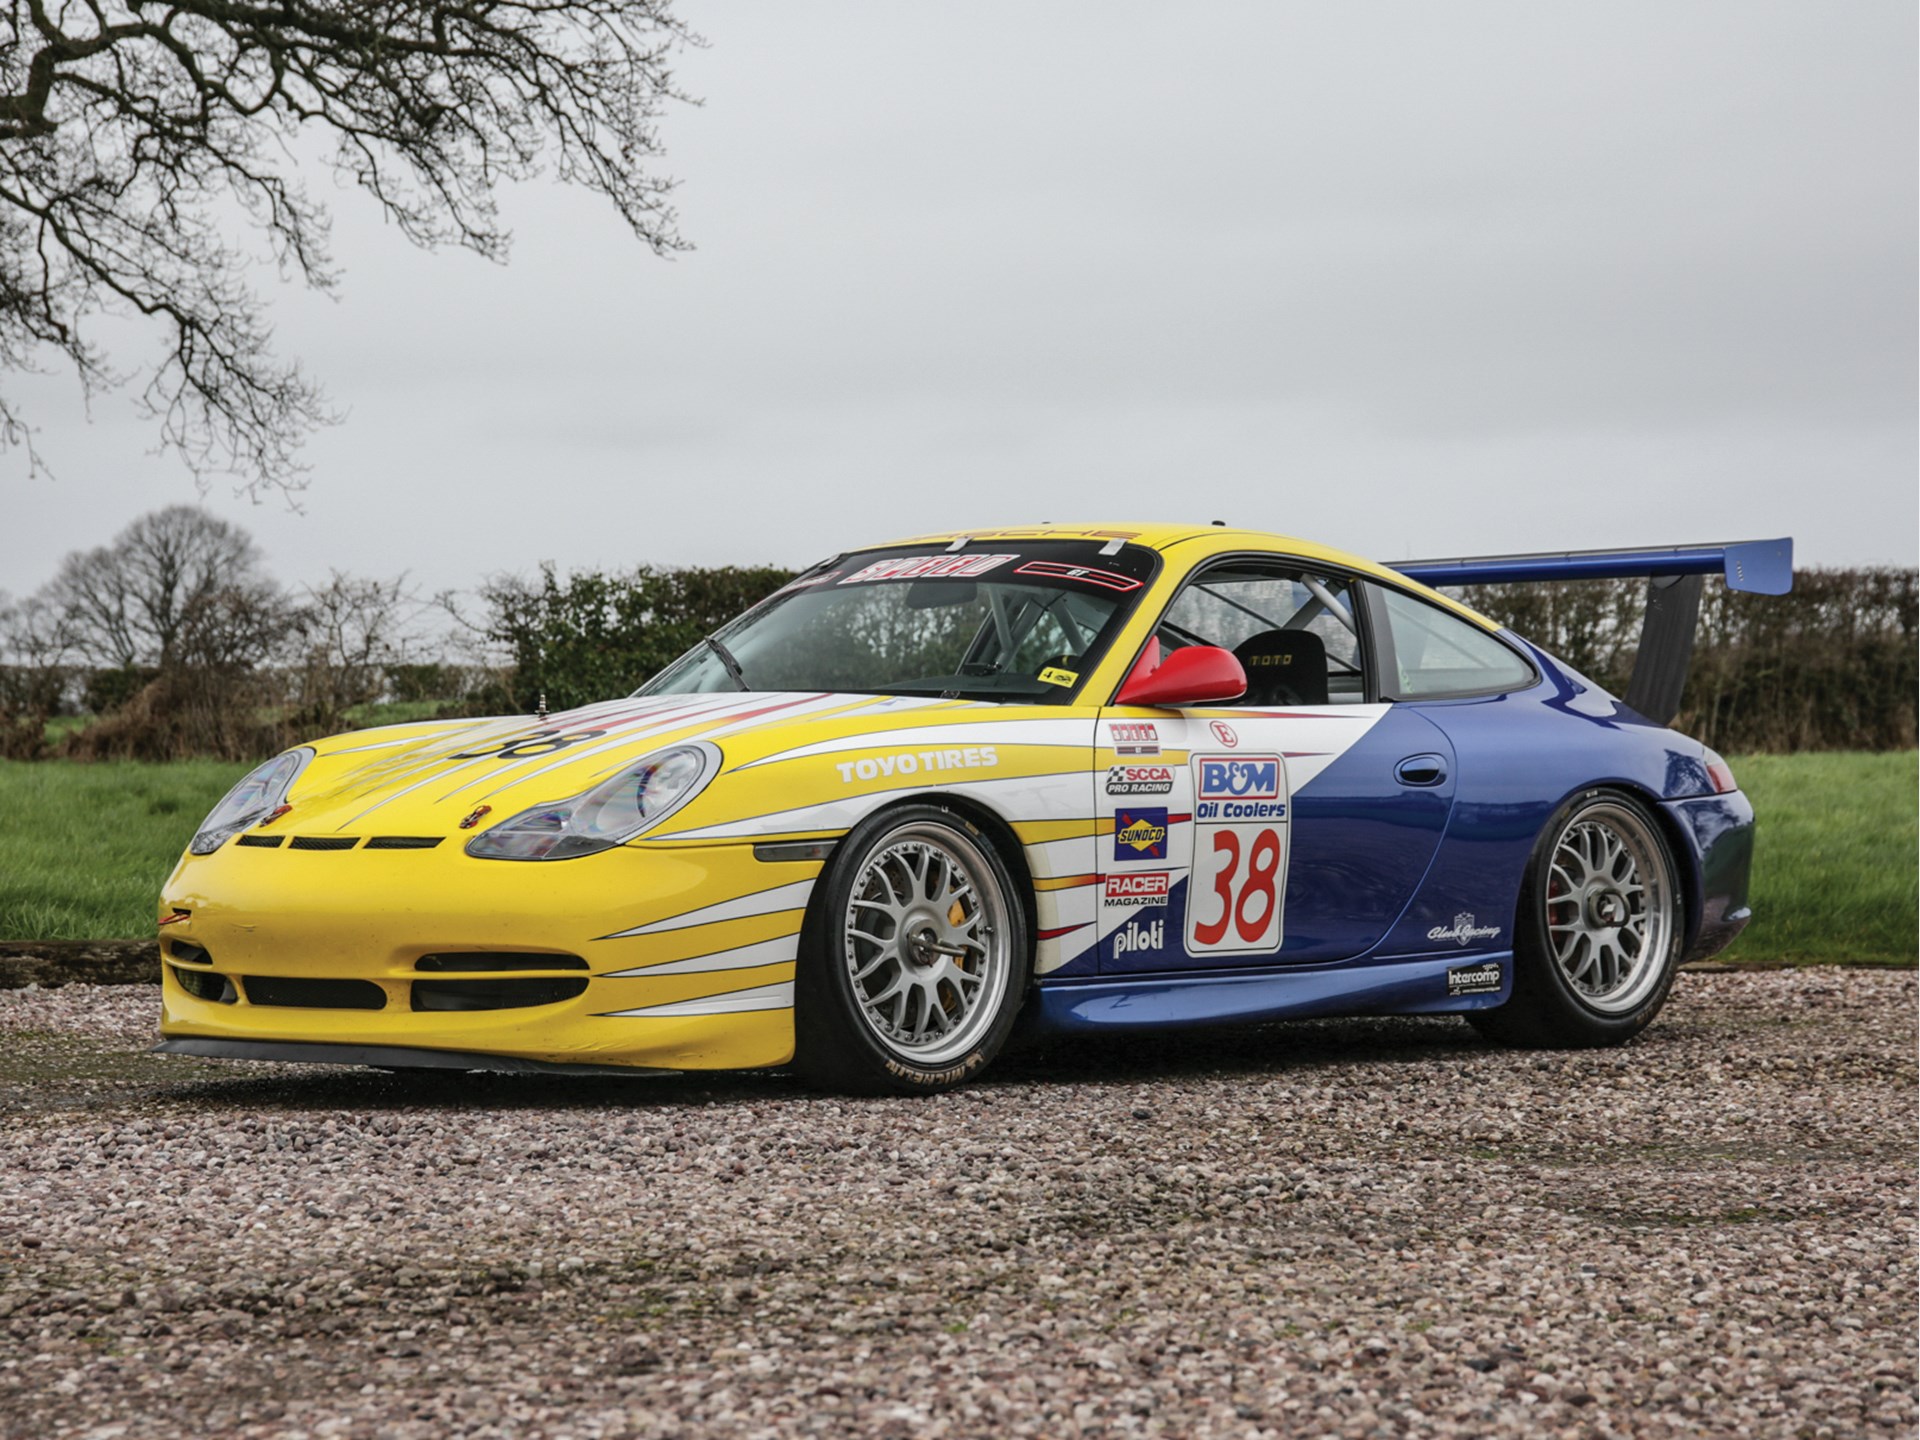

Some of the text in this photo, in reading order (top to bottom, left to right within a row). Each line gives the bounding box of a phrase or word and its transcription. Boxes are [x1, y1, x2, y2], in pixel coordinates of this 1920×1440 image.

[836, 553, 1021, 586] SPEED
[1250, 654, 1293, 666] TOTO
[1109, 724, 1158, 741] SPEED
[447, 730, 607, 760] 38
[836, 746, 998, 783] TOYO TIRES
[1126, 768, 1172, 781] SCCA
[1202, 762, 1276, 795] B&M
[1108, 783, 1171, 793] PRO RACING
[1197, 802, 1286, 818] Oil Coolers
[1119, 829, 1163, 843] SUNOCO
[1108, 876, 1167, 894] RACER
[1194, 828, 1280, 945] 38
[1104, 896, 1167, 907] MAGAZINE
[1113, 919, 1164, 959] piloti
[1448, 970, 1500, 985] Intercomp
